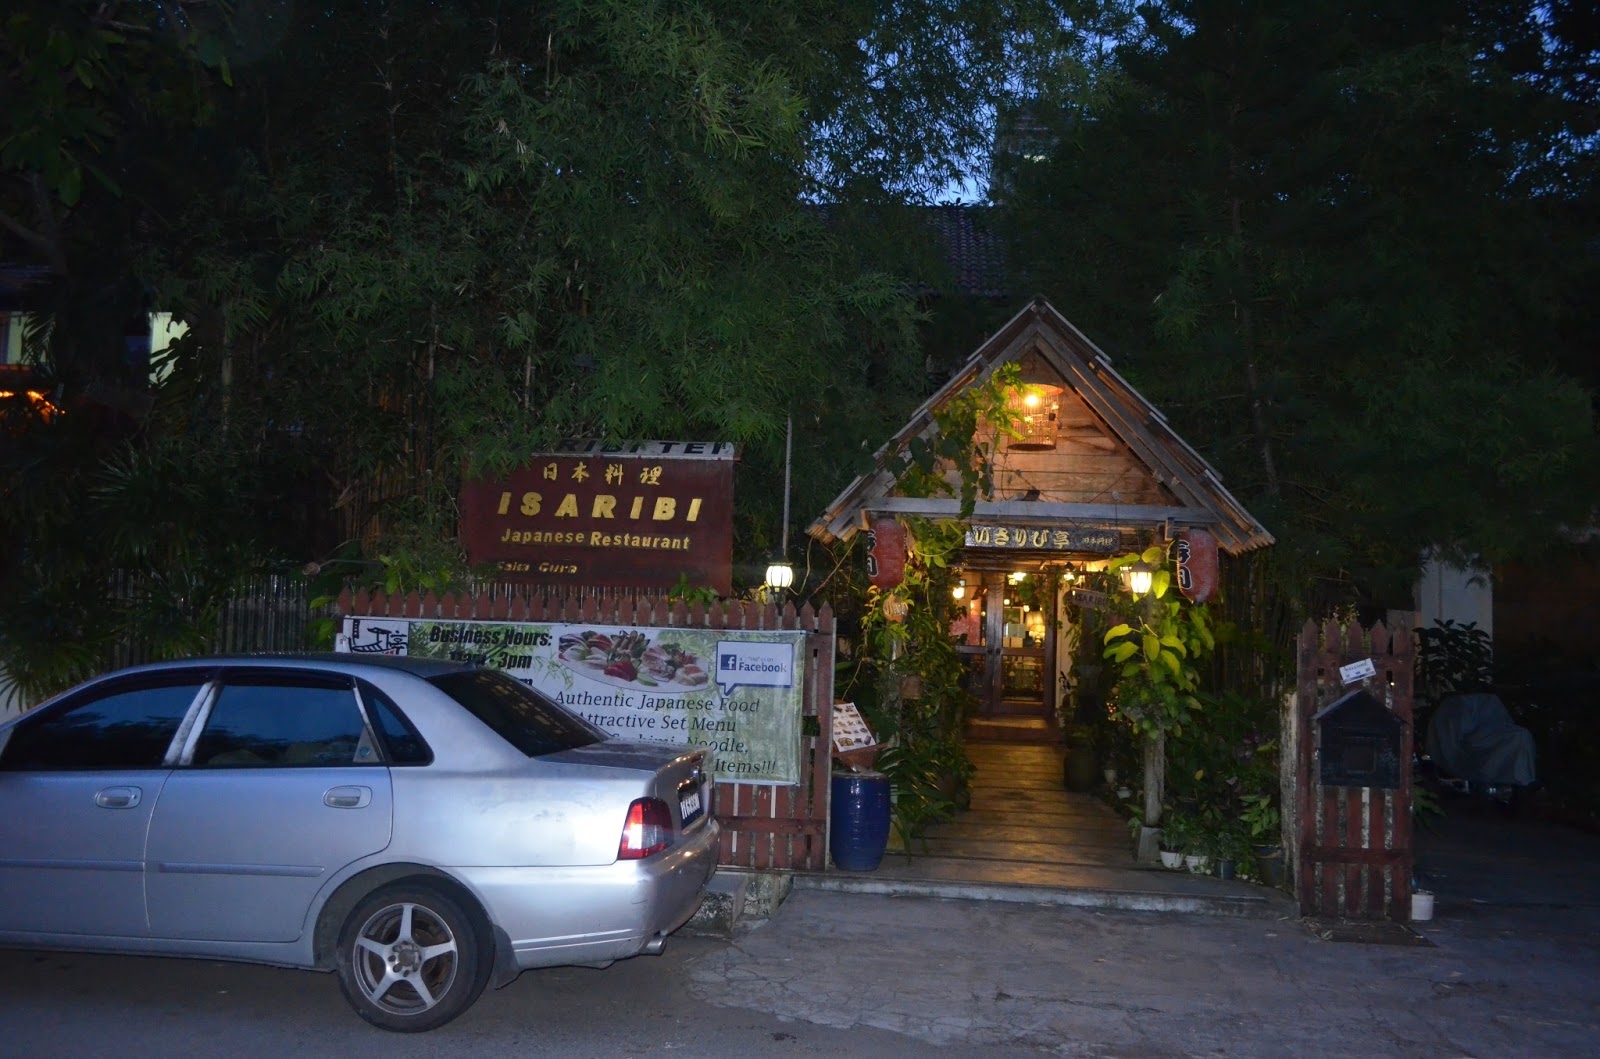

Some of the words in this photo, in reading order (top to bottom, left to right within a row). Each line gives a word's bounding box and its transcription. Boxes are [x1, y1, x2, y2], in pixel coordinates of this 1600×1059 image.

[543, 461, 663, 486] 日本料理
[497, 491, 702, 522] ISARIBI
[501, 528, 585, 544] Japanese
[590, 531, 690, 551] Restaurant
[974, 527, 1071, 550] いさりび亭
[430, 625, 501, 645] Business
[504, 627, 553, 647] Hours:
[498, 652, 532, 669] 3pm
[738, 662, 787, 673] Facebook
[555, 691, 633, 708] Authentic
[637, 695, 713, 713] Japanese
[719, 698, 760, 713] Food
[578, 712, 656, 729] Attractive
[660, 716, 686, 730] Set
[690, 720, 736, 732] Menu
[714, 759, 776, 775] Items!!!
